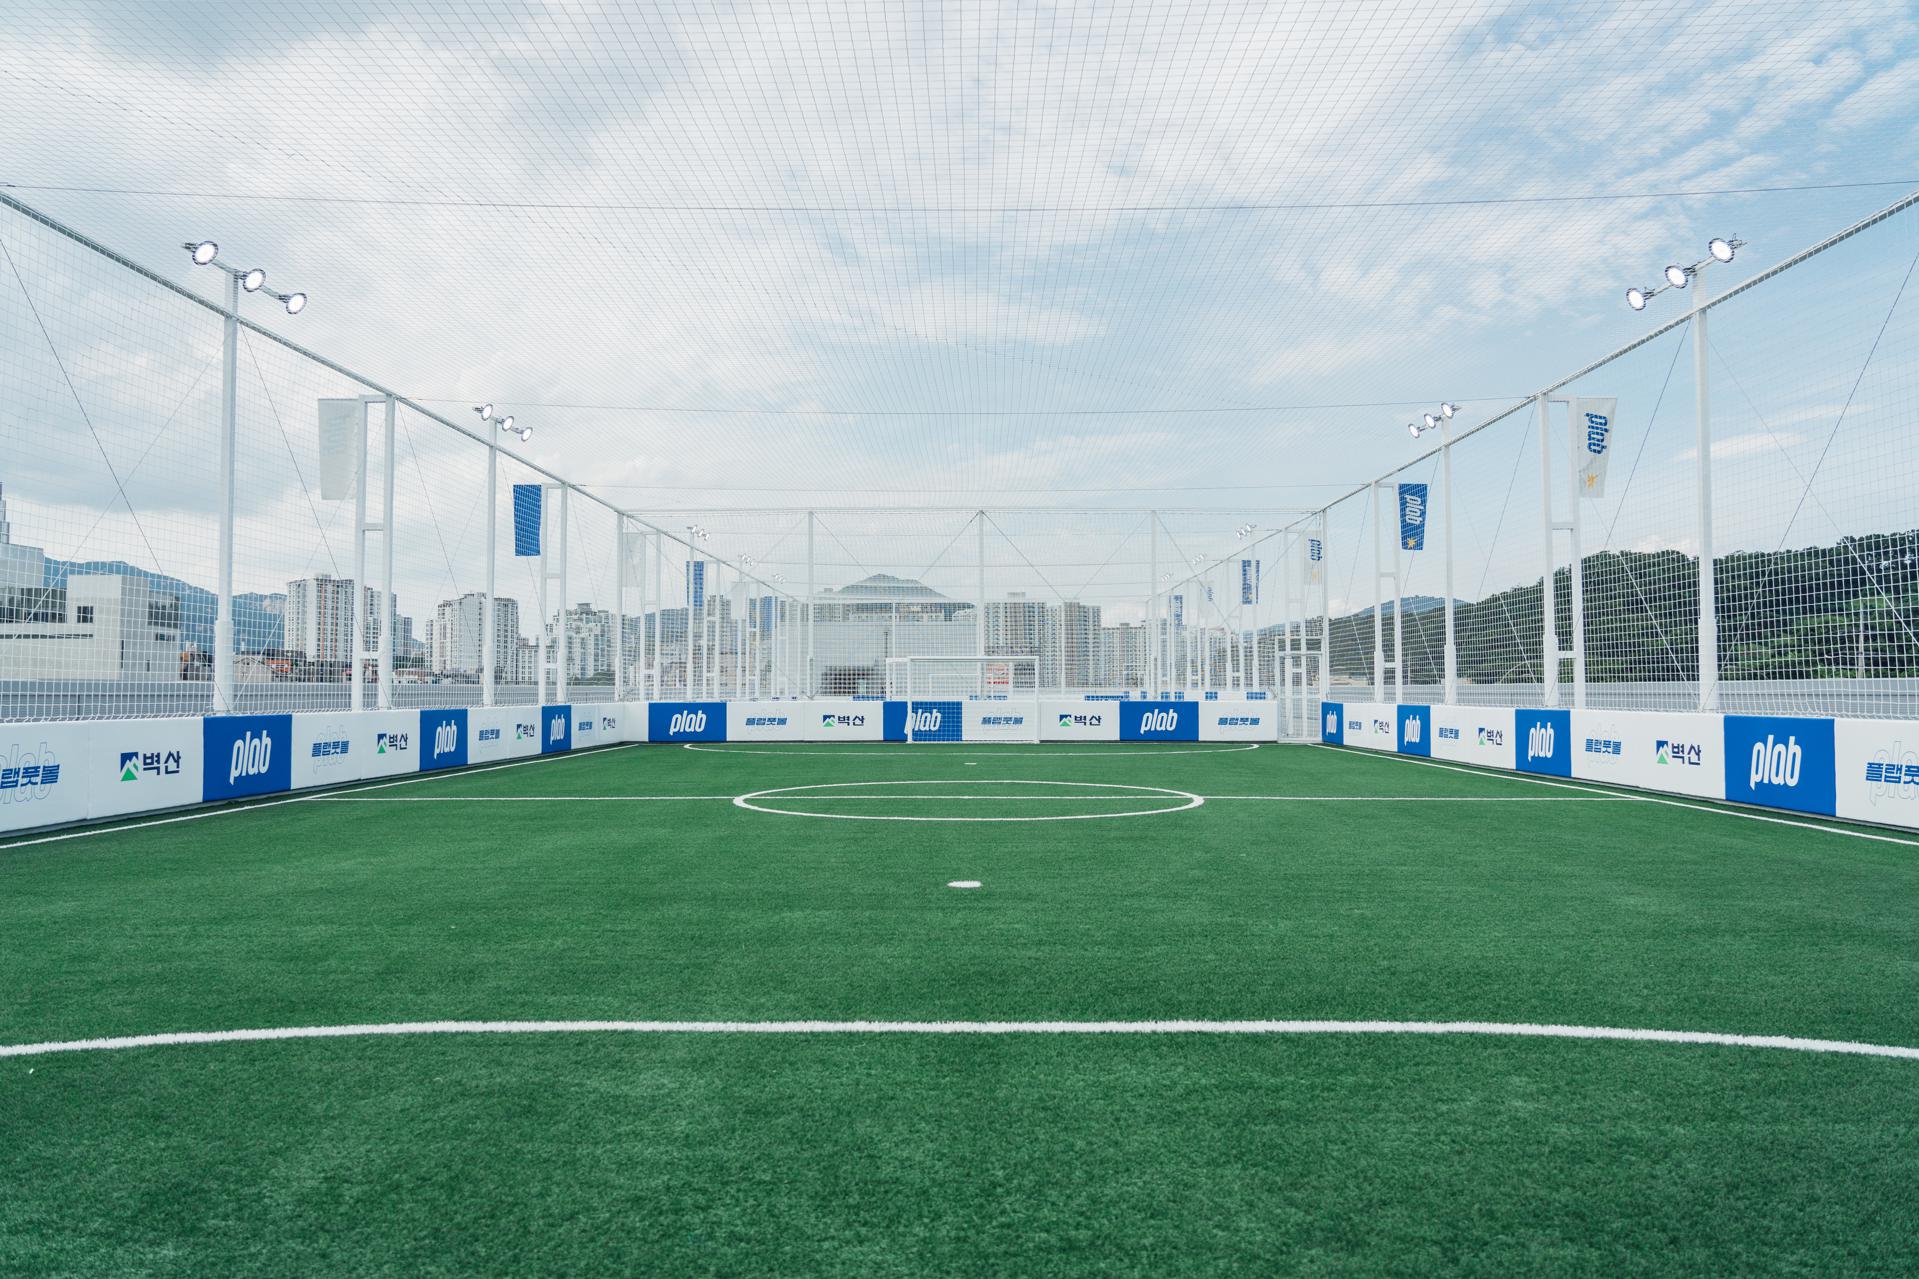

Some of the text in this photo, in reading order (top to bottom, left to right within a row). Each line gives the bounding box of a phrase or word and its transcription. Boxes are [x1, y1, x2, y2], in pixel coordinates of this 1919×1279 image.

[1585, 412, 1609, 454] plab
[1403, 494, 1424, 525] plab
[522, 724, 535, 738] 벽산
[550, 714, 565, 745] plab
[669, 710, 707, 736] plab
[837, 715, 865, 727] 벽산
[1074, 715, 1102, 727] 벽산
[1140, 708, 1178, 735] plab
[1404, 714, 1421, 747] plab
[388, 733, 408, 750] 벽산
[434, 719, 457, 760] plab
[1486, 729, 1503, 746] 벽산
[1528, 721, 1554, 763] plab
[143, 751, 181, 775] 벽산
[229, 730, 272, 786] plab
[1671, 743, 1702, 766] 벽산
[1750, 734, 1802, 790] plab
[0, 764, 60, 789] 랩풋볼
[1866, 762, 1919, 785] 플랩풋
